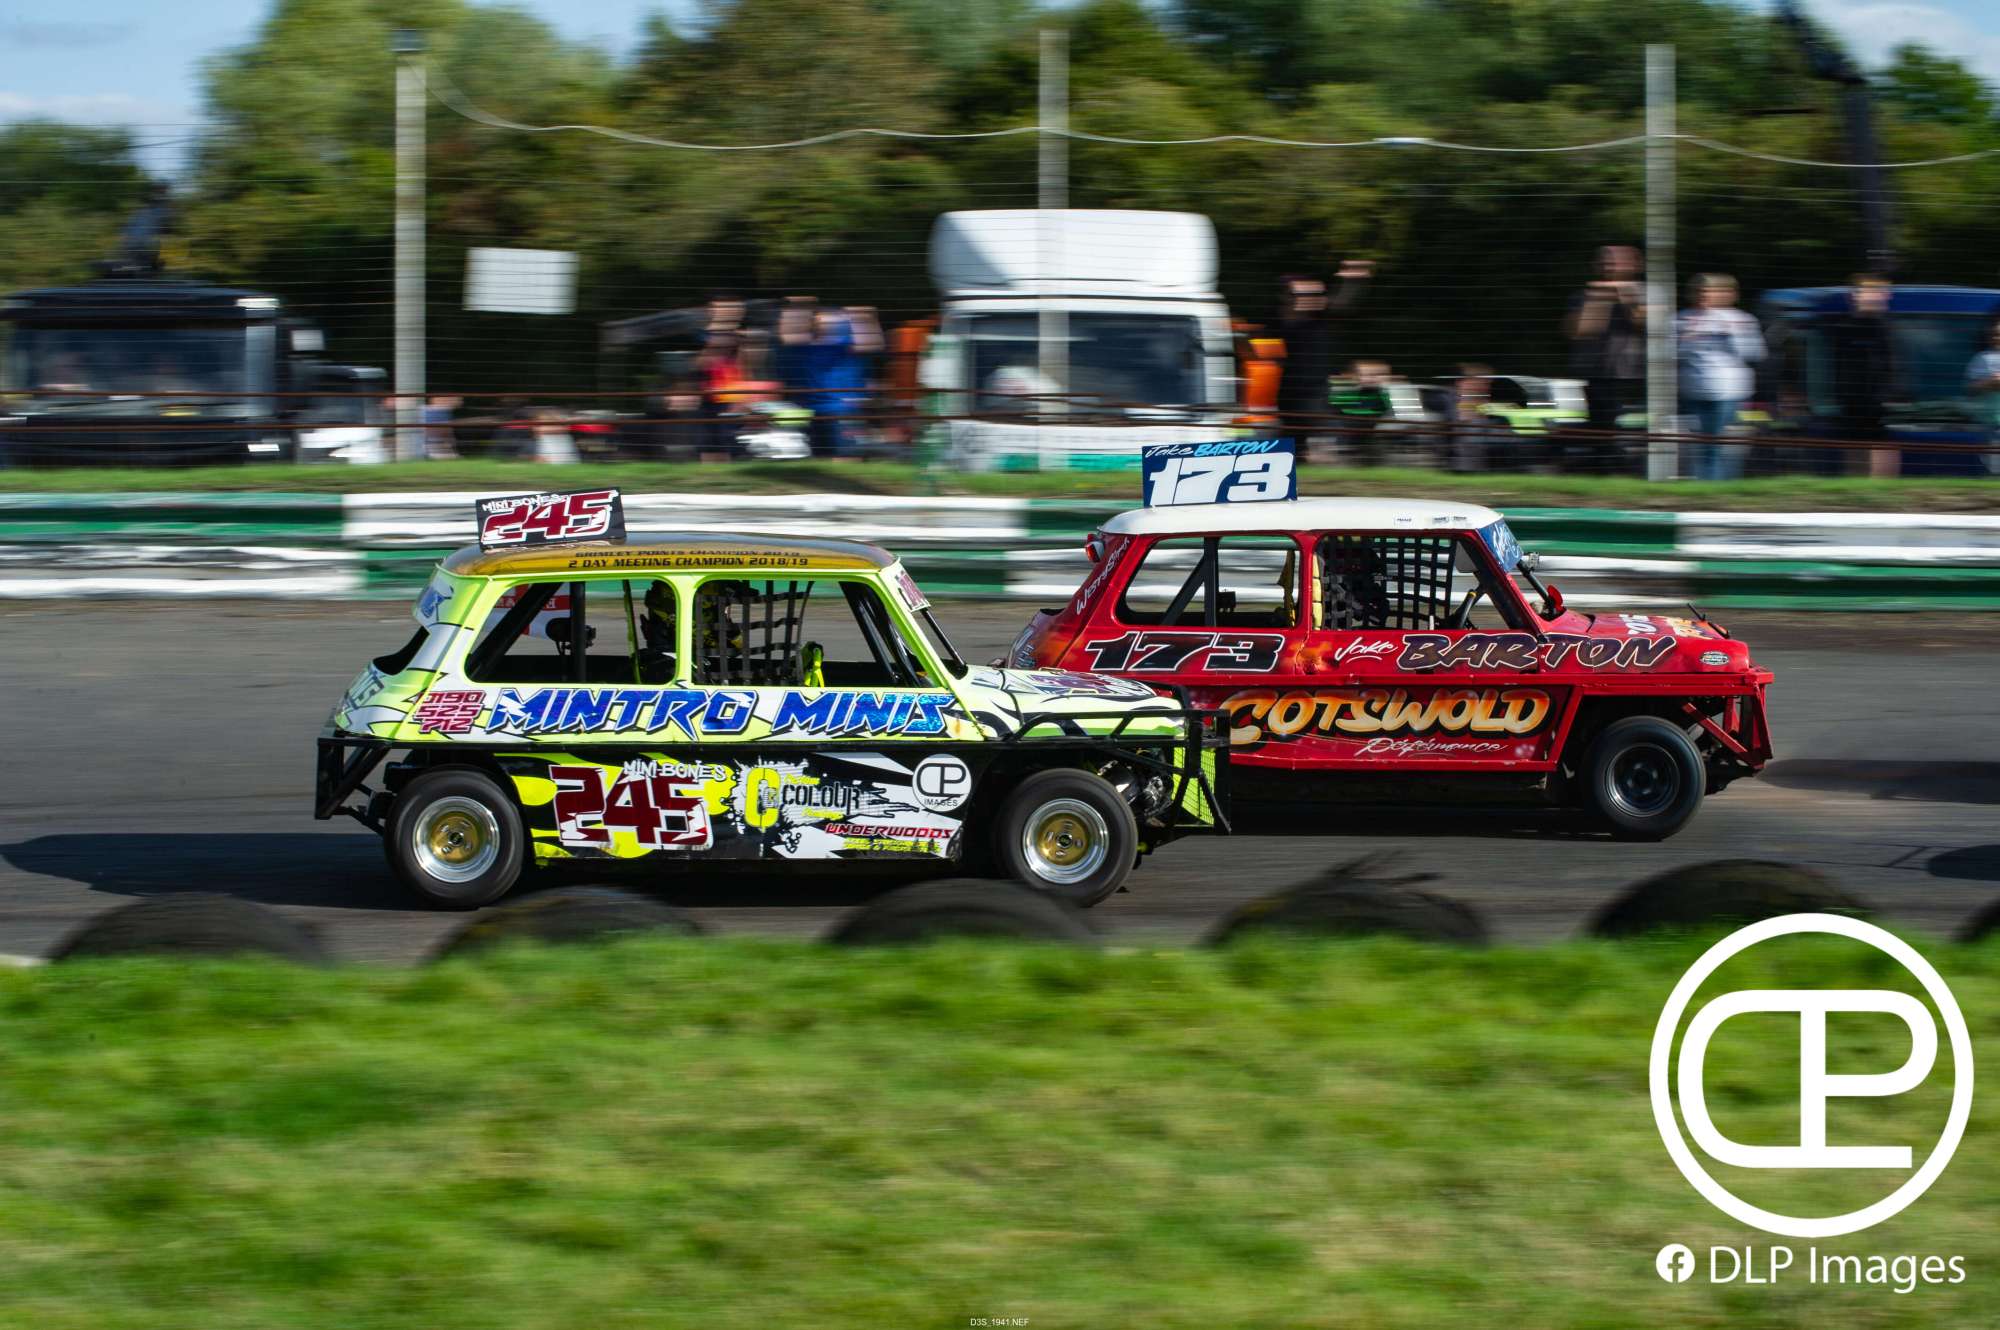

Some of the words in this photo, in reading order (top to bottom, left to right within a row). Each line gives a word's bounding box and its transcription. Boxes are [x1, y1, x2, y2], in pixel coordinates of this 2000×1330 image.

[1145, 445, 1194, 458] Jake
[1194, 440, 1279, 457] BARTON
[1149, 452, 1294, 507] 173
[480, 489, 619, 545] 245
[568, 560, 578, 568] 2
[583, 559, 608, 568] DAY
[613, 558, 672, 567] MEETING
[675, 557, 745, 566] CHAMPION
[749, 558, 809, 567] 2018/19
[1085, 631, 1285, 673] 173
[1334, 637, 1398, 661] Jake
[1398, 633, 1677, 670] BARTON
[414, 704, 483, 718] 525
[420, 717, 473, 732] 712
[484, 687, 758, 742] MINTRO
[771, 690, 955, 735] MINIS
[1218, 689, 1550, 745] COTSWOLD
[548, 764, 714, 850] 245
[782, 781, 860, 816] COLOUR
[924, 798, 959, 807] IMAGES
[825, 823, 955, 839] UNDERWOODS
